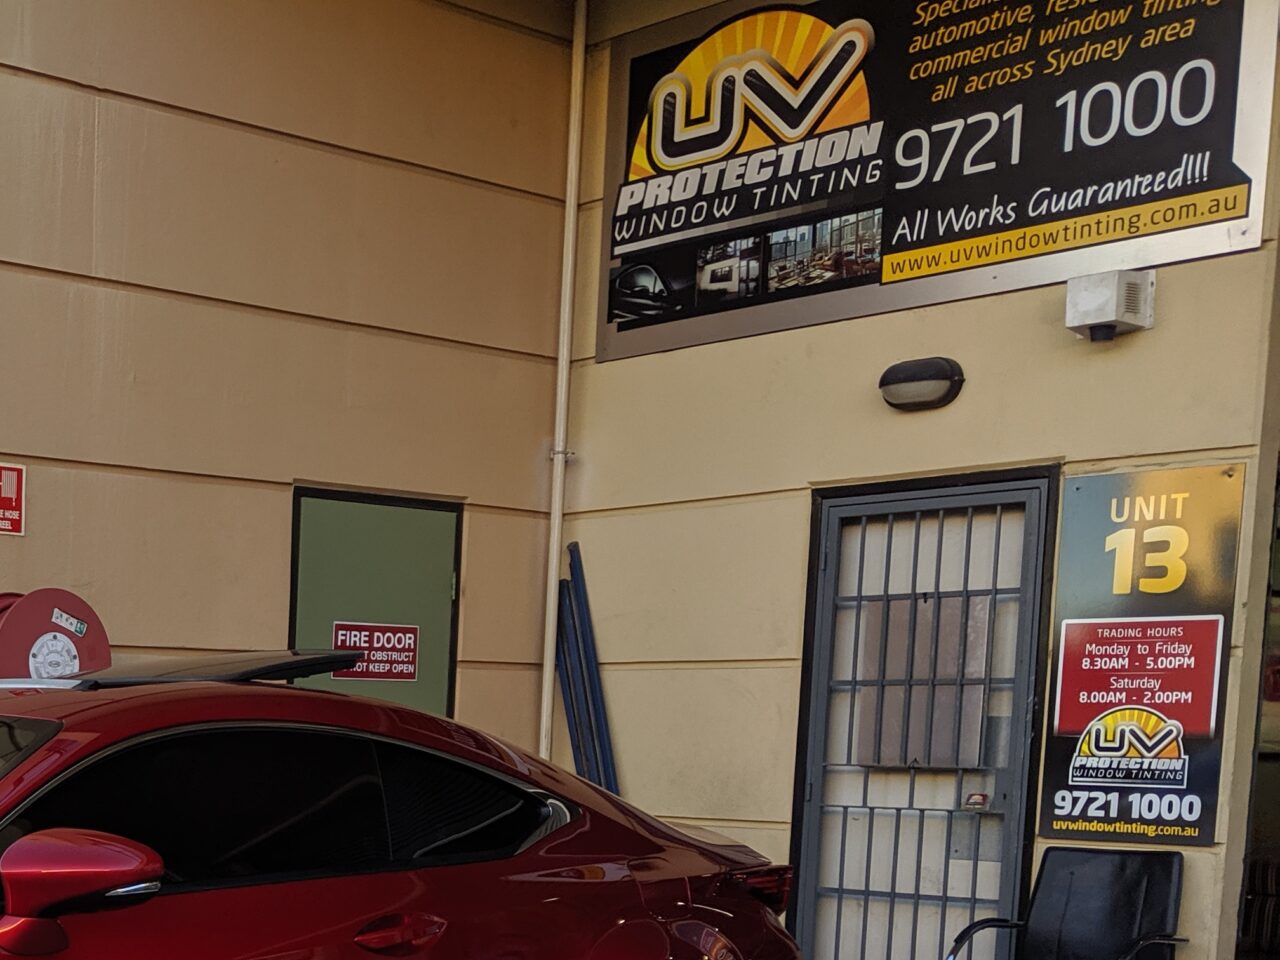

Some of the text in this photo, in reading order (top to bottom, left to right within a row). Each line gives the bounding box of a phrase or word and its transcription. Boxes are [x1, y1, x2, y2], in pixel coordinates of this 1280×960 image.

[908, 4, 1036, 54] automotive,
[909, 28, 1032, 80] commercial
[1038, 5, 1134, 47] window
[931, 18, 1196, 102] all across Sydney area
[655, 31, 864, 165] UV
[895, 58, 1216, 190] 9721 1000
[615, 121, 884, 216] PROTECTION
[614, 159, 883, 241] WINDOW TINTING
[892, 151, 1211, 244] All Works Guaranteed!!!
[890, 193, 1238, 276] www.uvwindowtinting.com.au
[1110, 492, 1190, 523] UNIT
[1104, 525, 1190, 595] 13
[337, 630, 414, 649] FIRE DOOR
[1097, 627, 1184, 638] TRADING HOURS
[370, 651, 414, 662] OBSTRUCT
[1081, 658, 1128, 670] 8.30AM
[1146, 656, 1195, 669] 5.00PM
[1085, 642, 1193, 656] Monday to Friday
[369, 663, 390, 672] KEEP
[392, 664, 414, 673] OPEN
[1110, 676, 1161, 690] Saturday
[1079, 692, 1126, 704] 8.00AM
[1143, 692, 1192, 704] 2.00PM
[1091, 724, 1178, 756] UV
[1073, 768, 1183, 780] WINDOW TINTING
[1075, 756, 1184, 770] PROTECTION
[1054, 790, 1202, 822] 9721 1000
[1052, 819, 1199, 837] uvwindowtinting.com.au
